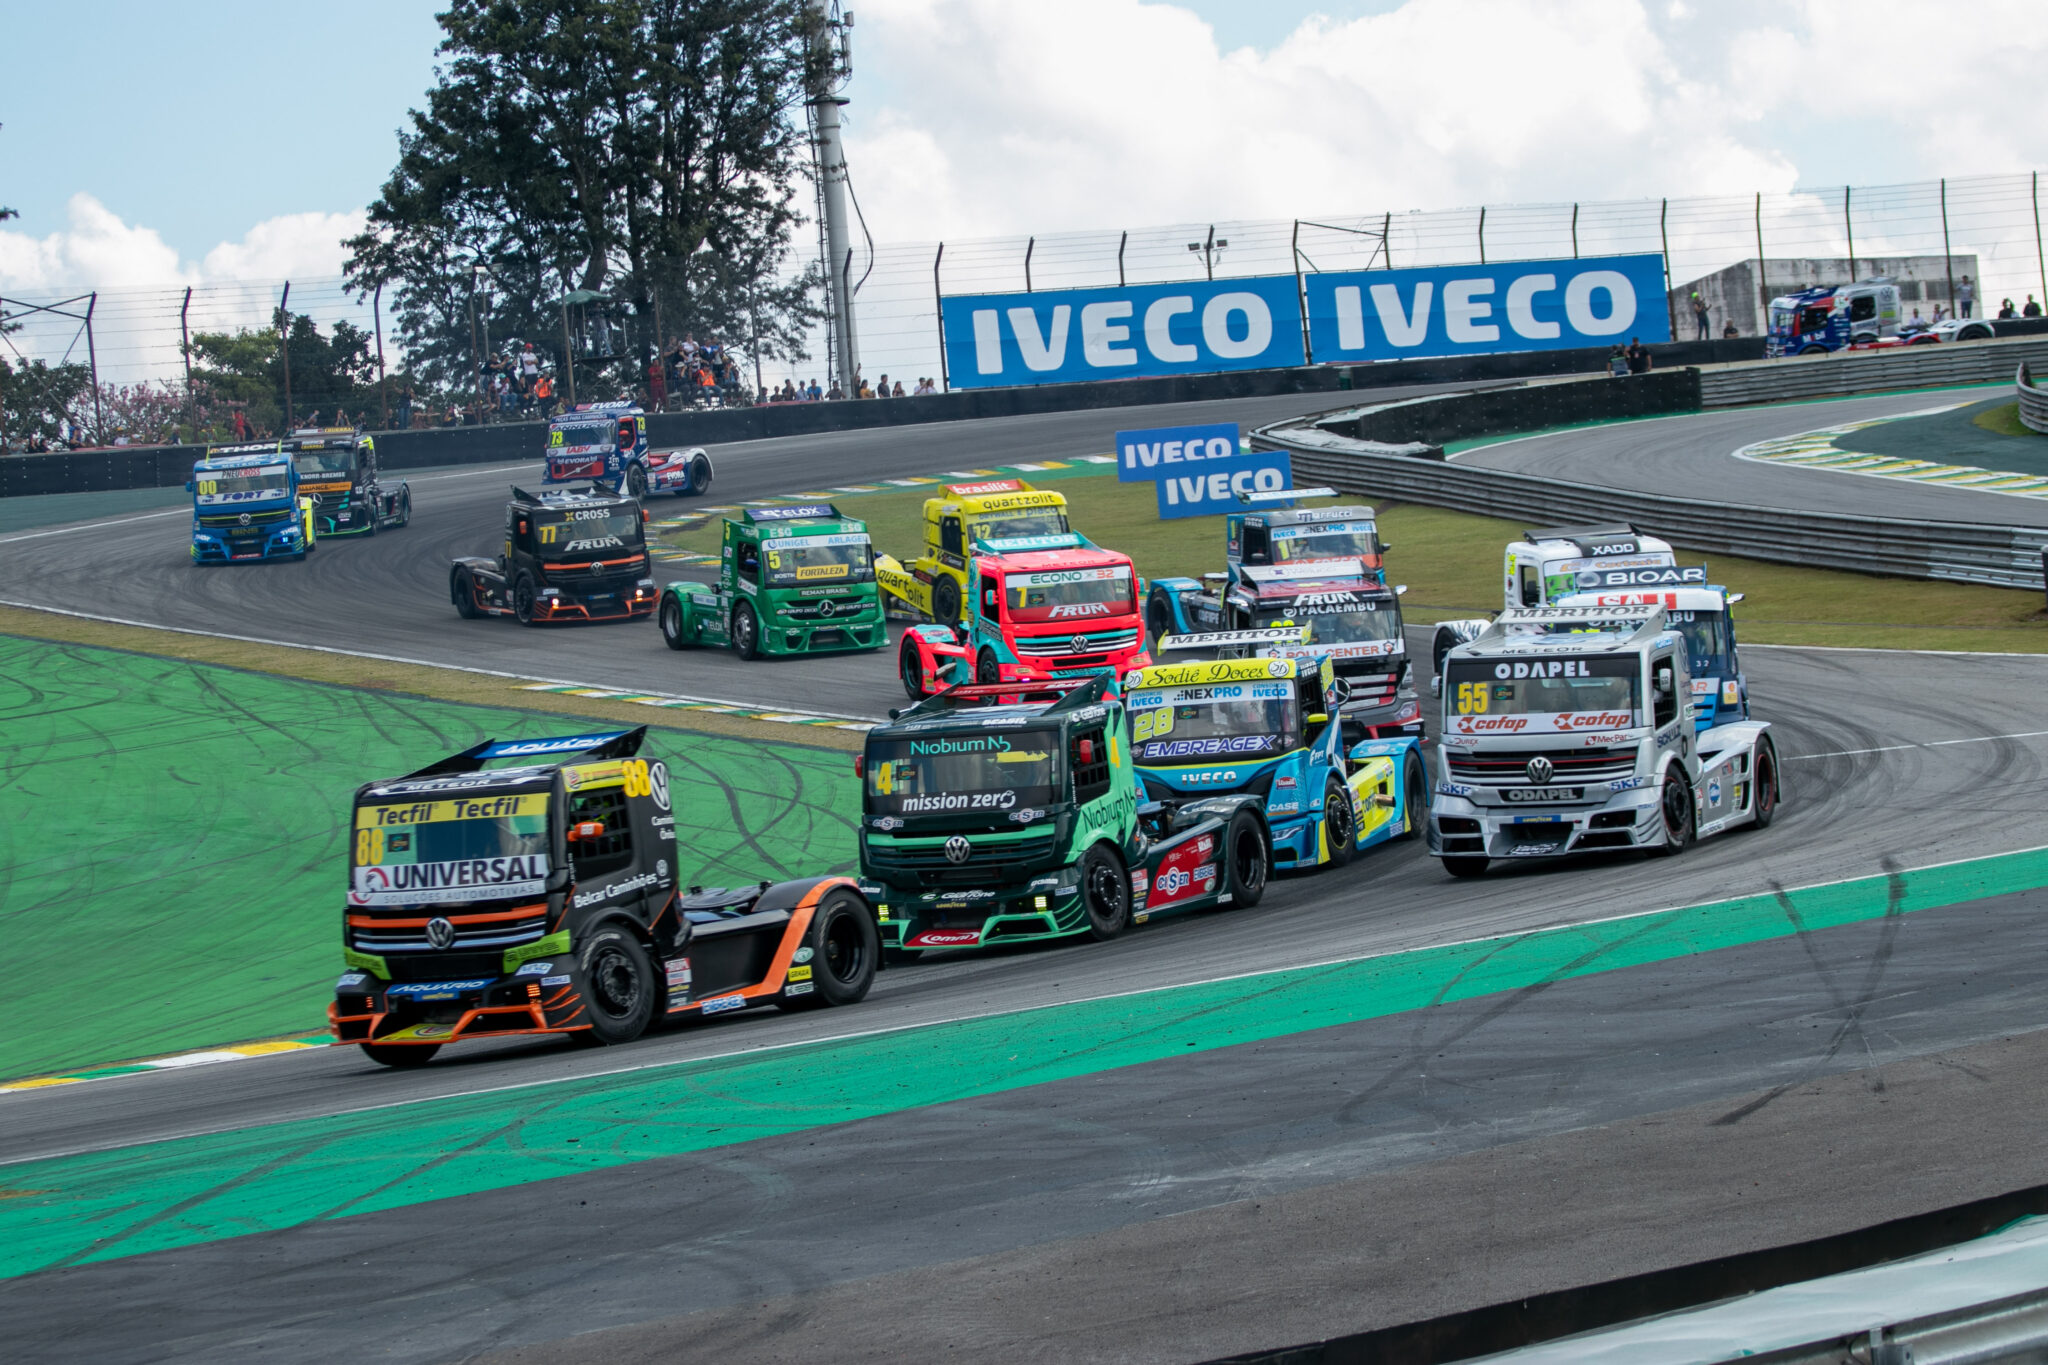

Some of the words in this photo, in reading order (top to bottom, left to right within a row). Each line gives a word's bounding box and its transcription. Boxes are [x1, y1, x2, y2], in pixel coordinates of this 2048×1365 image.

[1334, 269, 1637, 351] IVECO
[972, 291, 1273, 375] IVECO
[589, 400, 632, 410] EVORA
[636, 416, 646, 430] 73
[551, 431, 563, 444] 73
[219, 443, 278, 453] THOR
[1124, 437, 1232, 469] IVECO
[199, 480, 217, 495] 00
[951, 481, 1015, 495] brasilit
[1166, 467, 1284, 505] IVECO
[222, 490, 265, 501] FORT
[983, 494, 1056, 510] quartzolit
[539, 525, 556, 544] 77
[723, 522, 731, 540] 5
[769, 528, 792, 538] ESG
[840, 523, 862, 533] ESG
[973, 524, 991, 539] 12
[1309, 524, 1346, 533] NEXPRO
[564, 537, 624, 551] FRUM
[777, 539, 811, 548] UNIGEL
[828, 535, 867, 545] ARLAGEL
[985, 535, 1079, 550] MERITOR
[1277, 540, 1290, 560] 1
[1591, 543, 1635, 555] XADO
[768, 551, 781, 569] 5
[800, 567, 845, 577] FORTALEZA
[1030, 572, 1082, 584] ECONO
[1096, 569, 1115, 579] 32
[1606, 567, 1705, 585] BIOAR
[1016, 587, 1028, 607] 7
[1293, 591, 1360, 606] FRUM
[1048, 603, 1111, 618] FRUM
[1299, 602, 1376, 616] PACAEMBU
[1512, 606, 1650, 618] MERITOR
[1169, 628, 1301, 645] MERITOR
[1326, 646, 1379, 658] CENTER
[1502, 646, 1584, 654] METEOR
[1147, 668, 1200, 686] Sodiê
[1206, 663, 1264, 681] Doces
[1495, 661, 1590, 680] ODAPEL
[1184, 685, 1242, 700] NEXPRO
[1252, 688, 1288, 698] IVECO
[1457, 683, 1488, 714] 55
[1131, 697, 1163, 708] IVECO
[1133, 706, 1174, 744] 28
[1474, 716, 1528, 732] cofap
[1573, 712, 1630, 729] cofap
[910, 738, 985, 755] Niobium
[1144, 735, 1278, 758] EMBREAGEX
[1596, 734, 1627, 744] MecPar
[407, 779, 491, 791] METEOR
[622, 759, 651, 797] 88
[876, 762, 893, 795] 4
[1181, 771, 1237, 786] IVECO
[1610, 777, 1644, 791] SKF
[1441, 784, 1472, 795] SKF
[1508, 788, 1577, 801] ODAPEL
[453, 797, 520, 818] Tecfil
[902, 792, 969, 812] mission
[971, 789, 1016, 809] zero
[1269, 802, 1299, 812] CASE
[376, 804, 431, 825] Tecfil
[356, 829, 384, 867] 88
[394, 856, 544, 889] UNIVERSAL
[1156, 866, 1190, 896] CISER
[446, 885, 536, 900] AUTOMOTIVAS
[573, 890, 606, 908] Belcar
[605, 873, 658, 897] Caminhões
[933, 932, 973, 943] omni
[394, 980, 485, 992] AQUÁRIO
